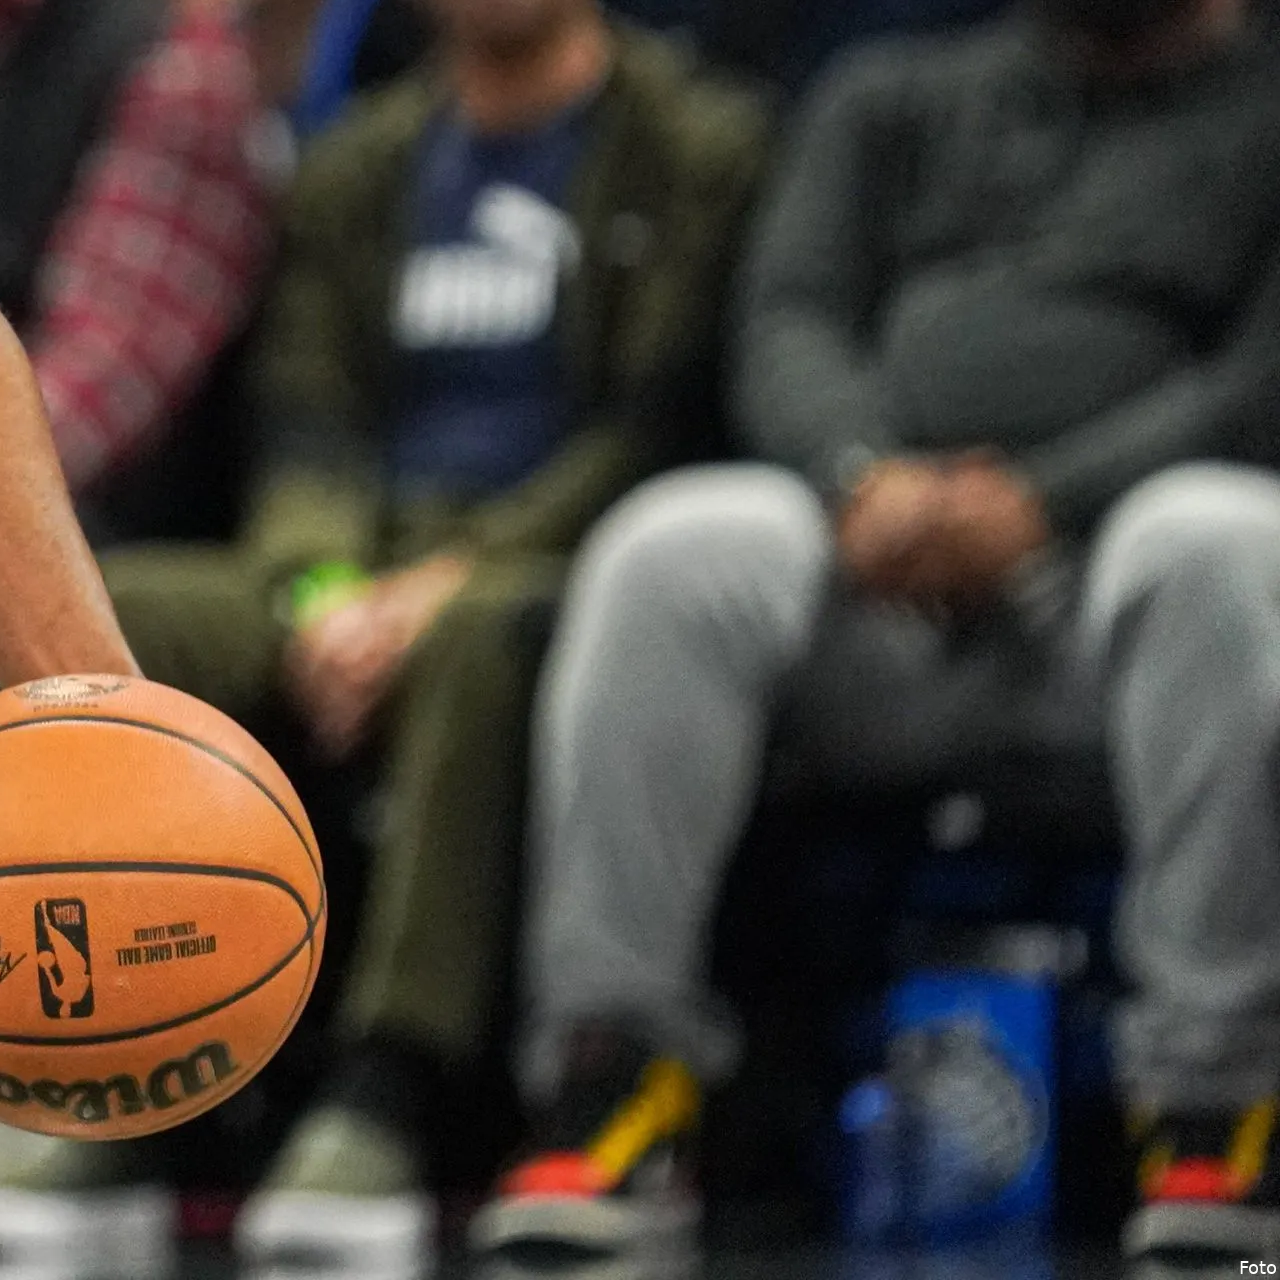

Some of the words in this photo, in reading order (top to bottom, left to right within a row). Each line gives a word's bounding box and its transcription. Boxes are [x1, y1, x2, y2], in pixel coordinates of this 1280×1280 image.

[54, 904, 81, 925] NBA
[116, 946, 142, 967] BALL
[143, 942, 173, 964] GAME
[174, 935, 217, 959] OFFICIAL
